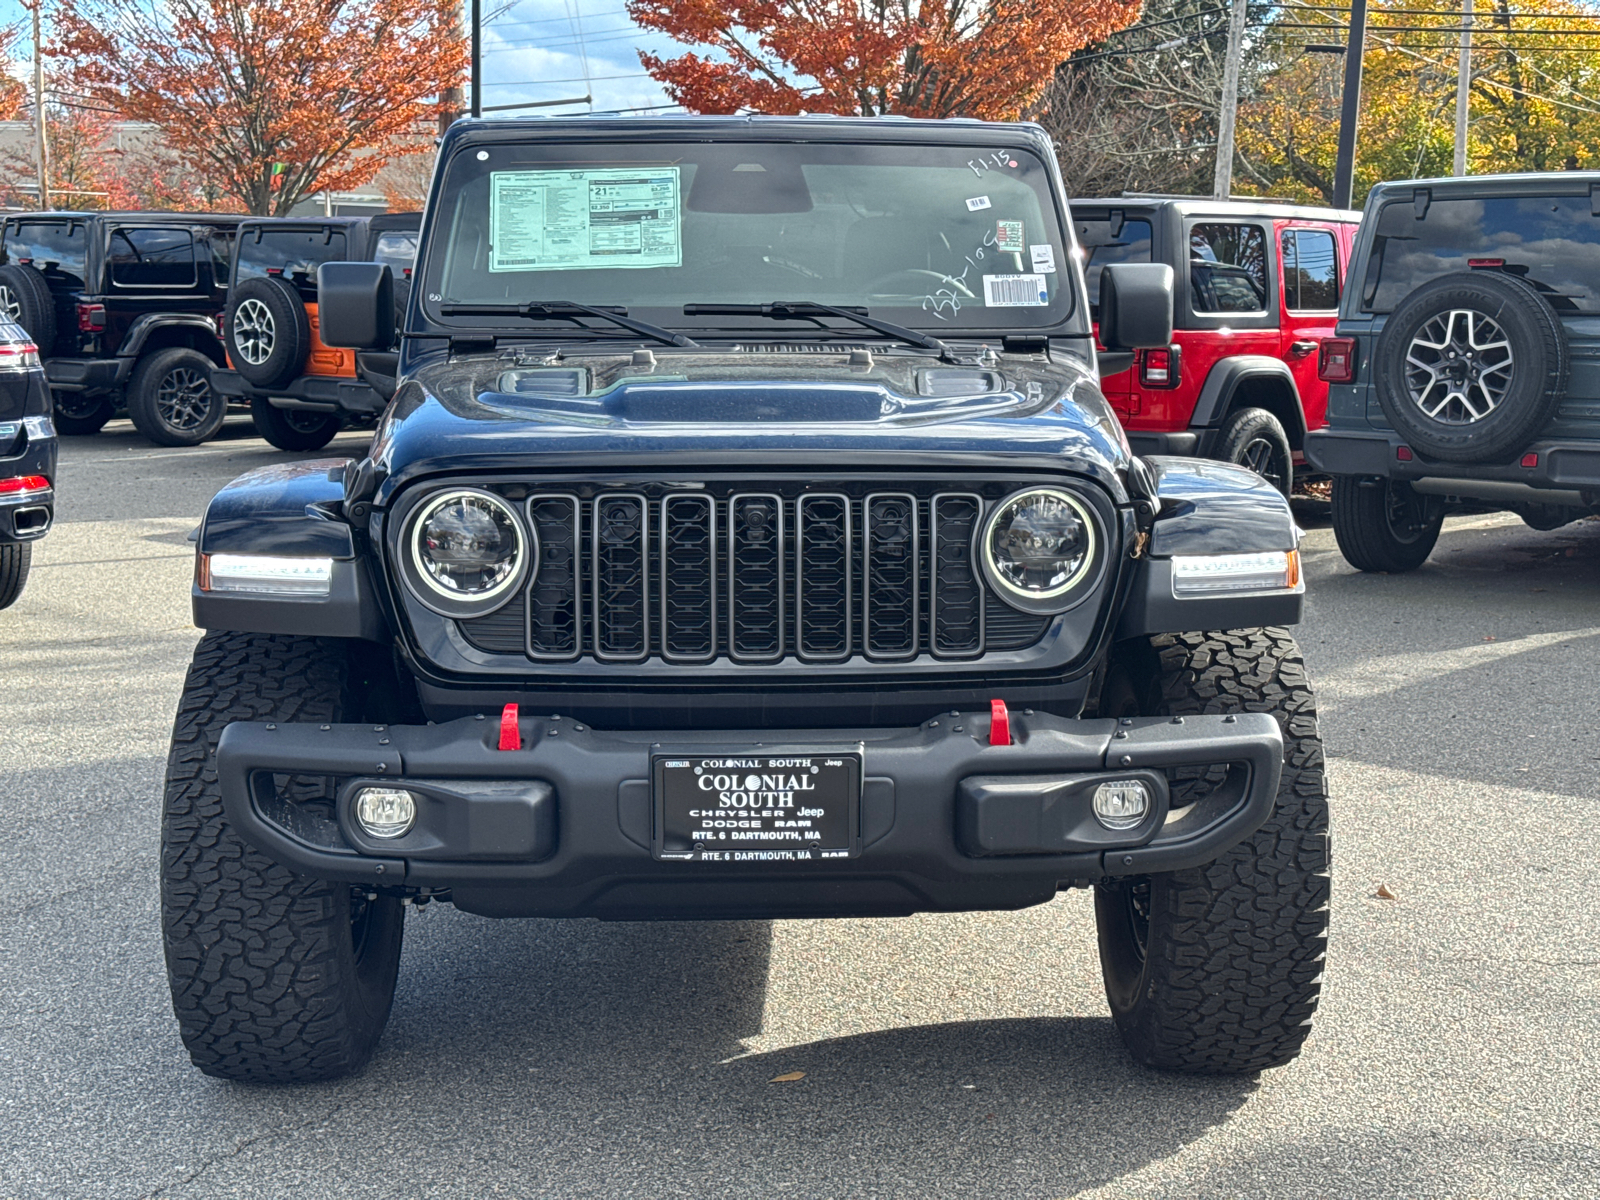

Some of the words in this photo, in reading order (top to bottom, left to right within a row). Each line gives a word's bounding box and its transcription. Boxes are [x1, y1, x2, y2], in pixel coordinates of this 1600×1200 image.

[594, 187, 607, 196] 21
[701, 759, 762, 768] COLONIAL
[769, 759, 812, 768] SOUTH
[825, 759, 843, 767] Jeep
[698, 774, 815, 791] COLONIAL
[719, 791, 794, 808] SOUTH
[797, 807, 824, 818] Jeep
[702, 820, 762, 828] DODGE
[774, 820, 812, 828] RAM
[692, 831, 717, 840] RTE.
[718, 831, 726, 840] 6
[731, 831, 802, 841] DARTMOUTH,
[804, 831, 821, 840] MA
[701, 852, 723, 861] RTE.
[724, 852, 730, 861] 6
[734, 852, 796, 861] DARTMOUTH,
[797, 851, 812, 860] MA
